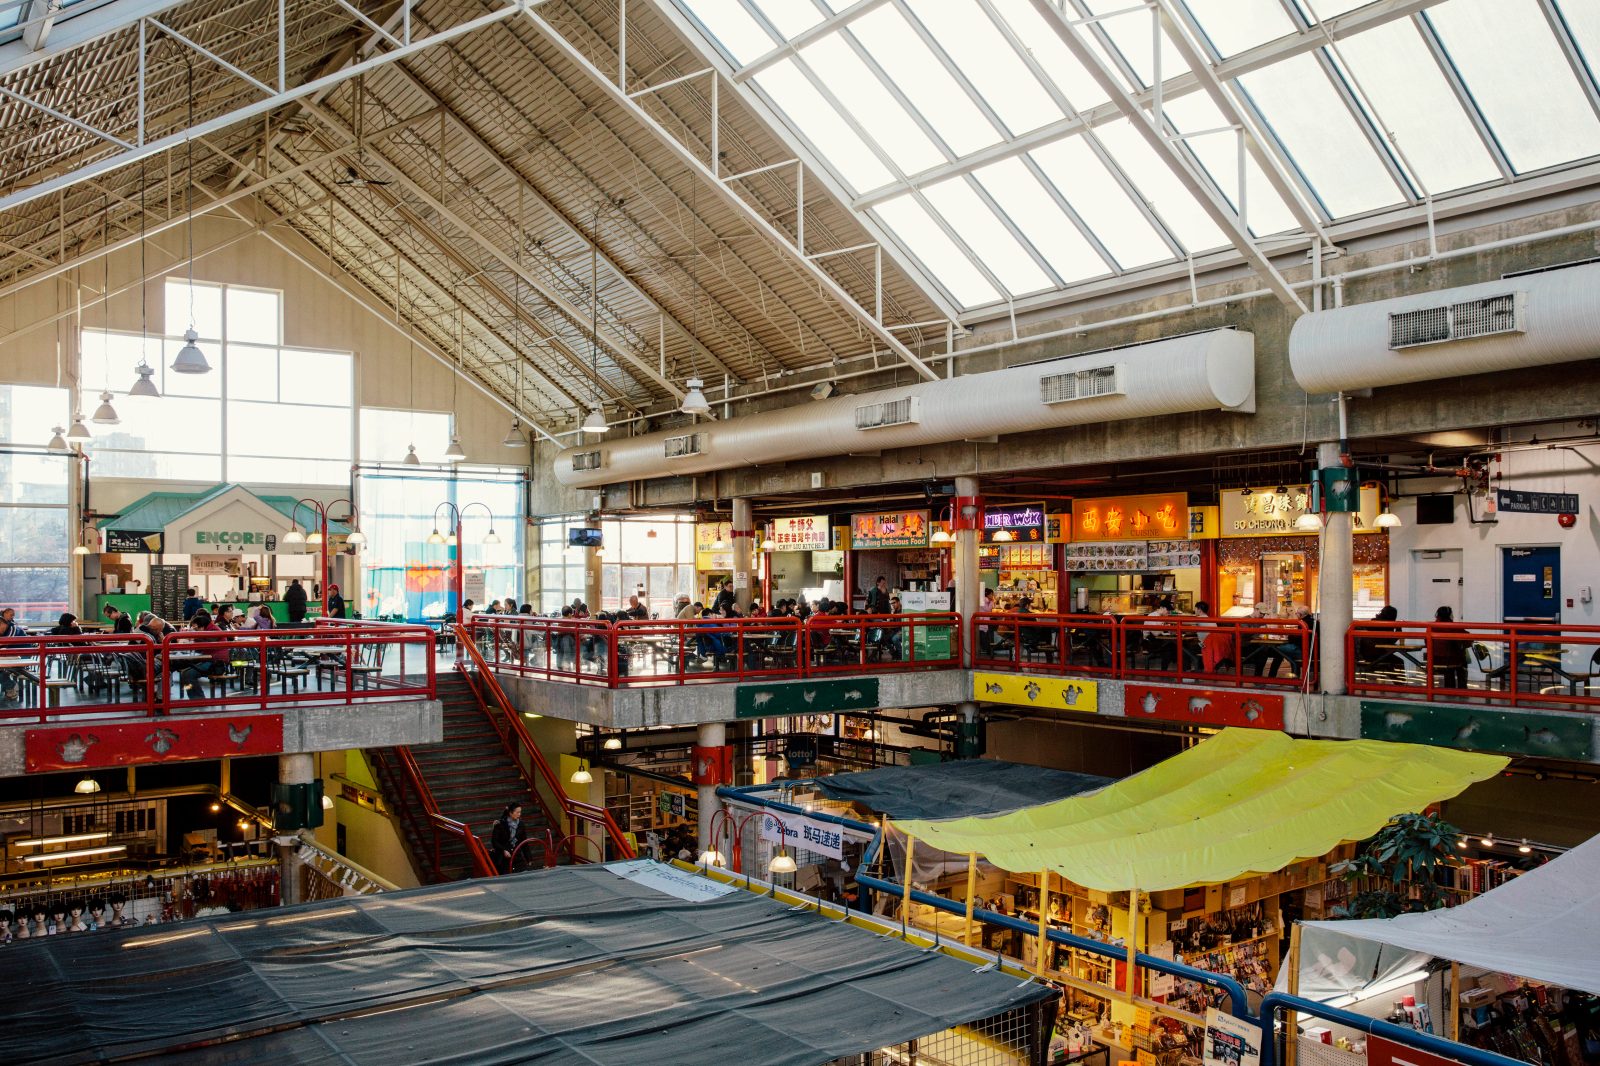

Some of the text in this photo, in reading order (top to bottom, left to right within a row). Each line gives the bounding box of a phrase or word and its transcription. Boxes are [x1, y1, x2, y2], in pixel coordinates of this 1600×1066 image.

[1510, 502, 1530, 510] PARKING
[880, 514, 898, 524] Halal
[1014, 510, 1041, 526] WOK
[1082, 504, 1177, 531] 西安小吃
[1234, 521, 1246, 530] BO
[1248, 518, 1284, 529] CHEONG
[196, 532, 264, 544] ENCORE
[1130, 529, 1160, 537] CUISINE
[882, 538, 908, 546] Delicious
[803, 824, 840, 850] 斑马速递
